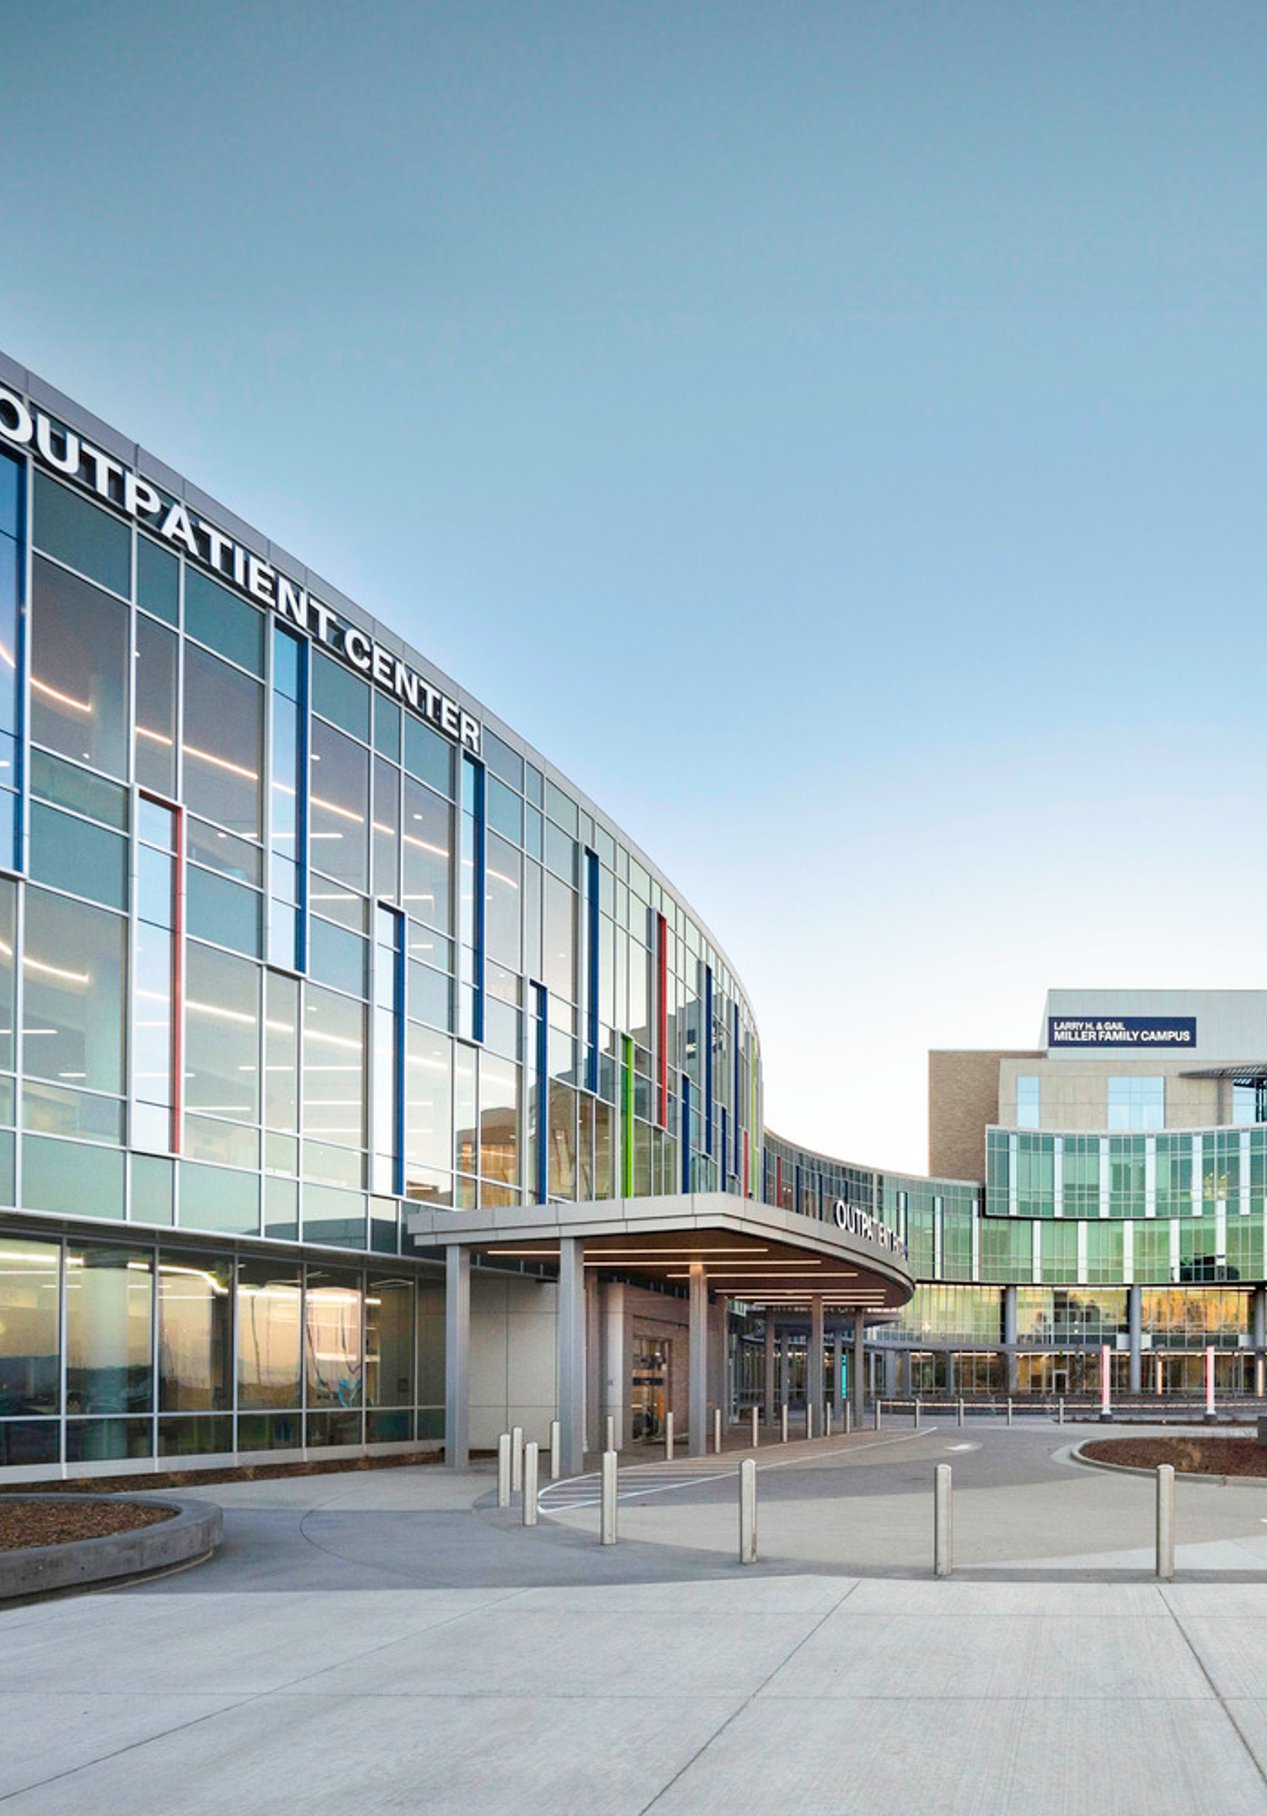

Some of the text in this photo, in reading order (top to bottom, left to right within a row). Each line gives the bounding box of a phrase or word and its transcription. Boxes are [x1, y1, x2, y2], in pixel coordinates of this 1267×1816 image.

[0, 387, 480, 752] OUTPATIENT CENTER
[1054, 1022, 1084, 1030] LARRY
[1104, 1022, 1126, 1030] GAIL
[1054, 1031, 1190, 1041] MILLER FAMILY CAMPUS
